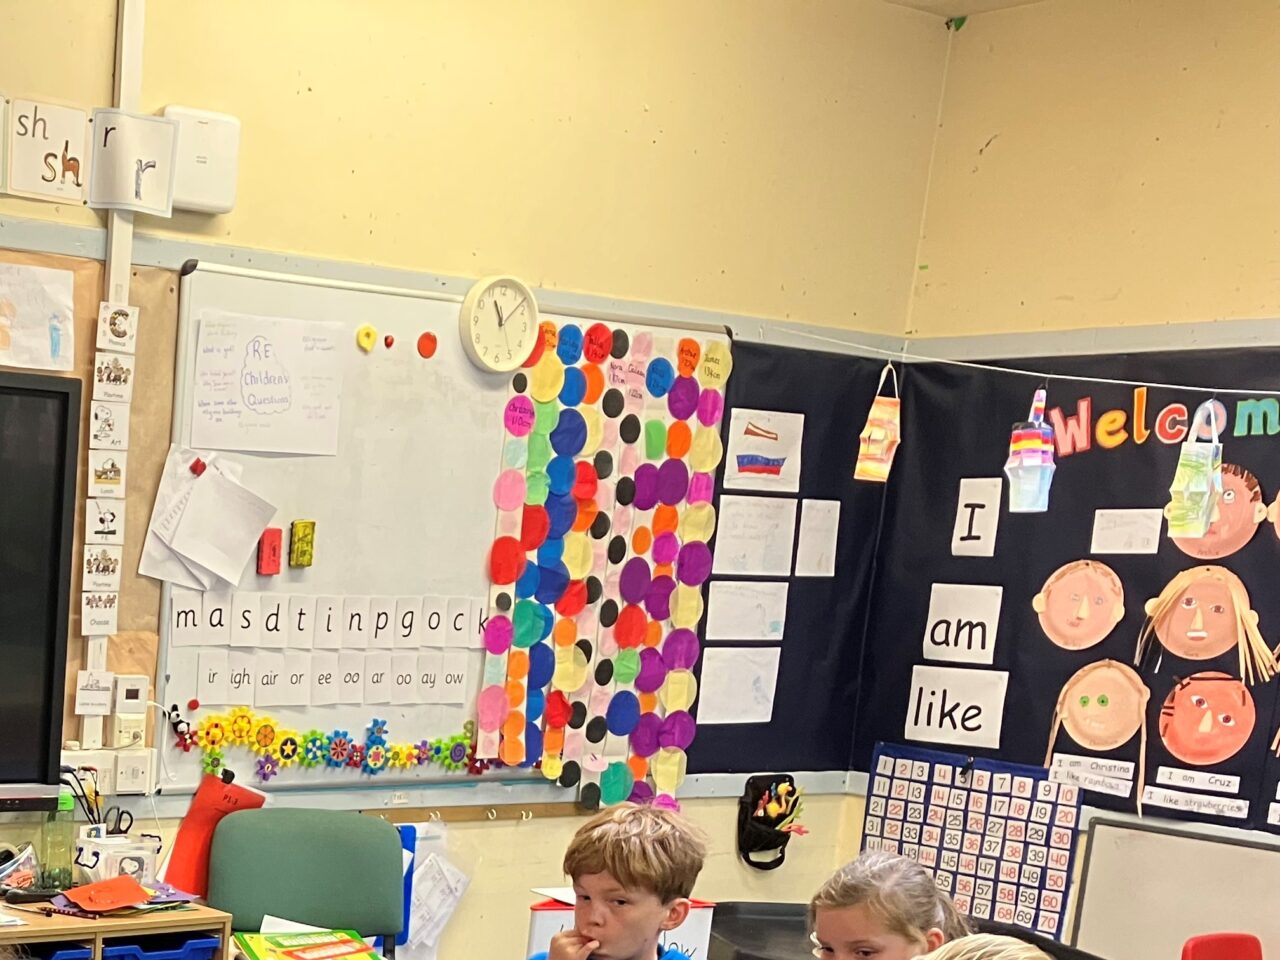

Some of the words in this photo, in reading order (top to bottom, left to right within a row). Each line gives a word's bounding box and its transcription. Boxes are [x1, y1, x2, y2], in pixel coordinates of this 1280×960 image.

[16, 106, 49, 140] sh
[103, 124, 116, 147] r
[41, 139, 83, 187] sh
[135, 158, 156, 199] r
[500, 285, 507, 296] 12
[520, 305, 525, 315] 2
[522, 322, 526, 332] 3
[483, 346, 488, 356] 7
[494, 353, 500, 363] 6
[959, 503, 985, 541] I
[176, 609, 197, 628] m
[209, 608, 224, 627] a
[241, 610, 252, 629] s
[265, 603, 280, 631] d
[298, 608, 306, 631] t
[326, 607, 332, 632] i
[349, 612, 362, 631] n
[375, 611, 388, 638] p
[402, 611, 414, 638] g
[428, 611, 440, 630] o
[453, 613, 464, 631] c
[478, 608, 489, 634] k
[930, 617, 988, 651] am
[208, 668, 218, 683] ir
[230, 668, 251, 689] igh
[261, 670, 278, 685] air
[290, 673, 304, 684] or
[318, 673, 332, 684] ee
[344, 672, 360, 684] oo
[372, 672, 384, 684] ar
[396, 673, 412, 685] oo
[421, 672, 436, 689] ay
[445, 673, 464, 684] ow
[912, 686, 983, 732] like
[1058, 759, 1062, 767] I
[1090, 762, 1130, 773] Christina
[883, 760, 887, 770] 1
[900, 764, 907, 774] 2
[917, 766, 924, 777] 3
[938, 768, 946, 779] 4
[977, 775, 983, 786] 6
[999, 778, 1006, 789] 7
[1018, 781, 1026, 793] 8
[1043, 784, 1051, 796] 9
[1062, 789, 1073, 801] 10
[1054, 771, 1058, 779] I
[1067, 771, 1080, 782] like
[1168, 772, 1172, 780] I
[1182, 775, 1195, 783] am
[1208, 776, 1232, 787] Cruz
[1148, 791, 1153, 799] I
[1164, 794, 1179, 805] like
[1054, 832, 1069, 845] 30
[1023, 870, 1038, 883] 49
[1020, 891, 1036, 904] 59
[1043, 895, 1058, 908] 60
[1017, 910, 1031, 924] 69
[1040, 916, 1055, 929] 70
